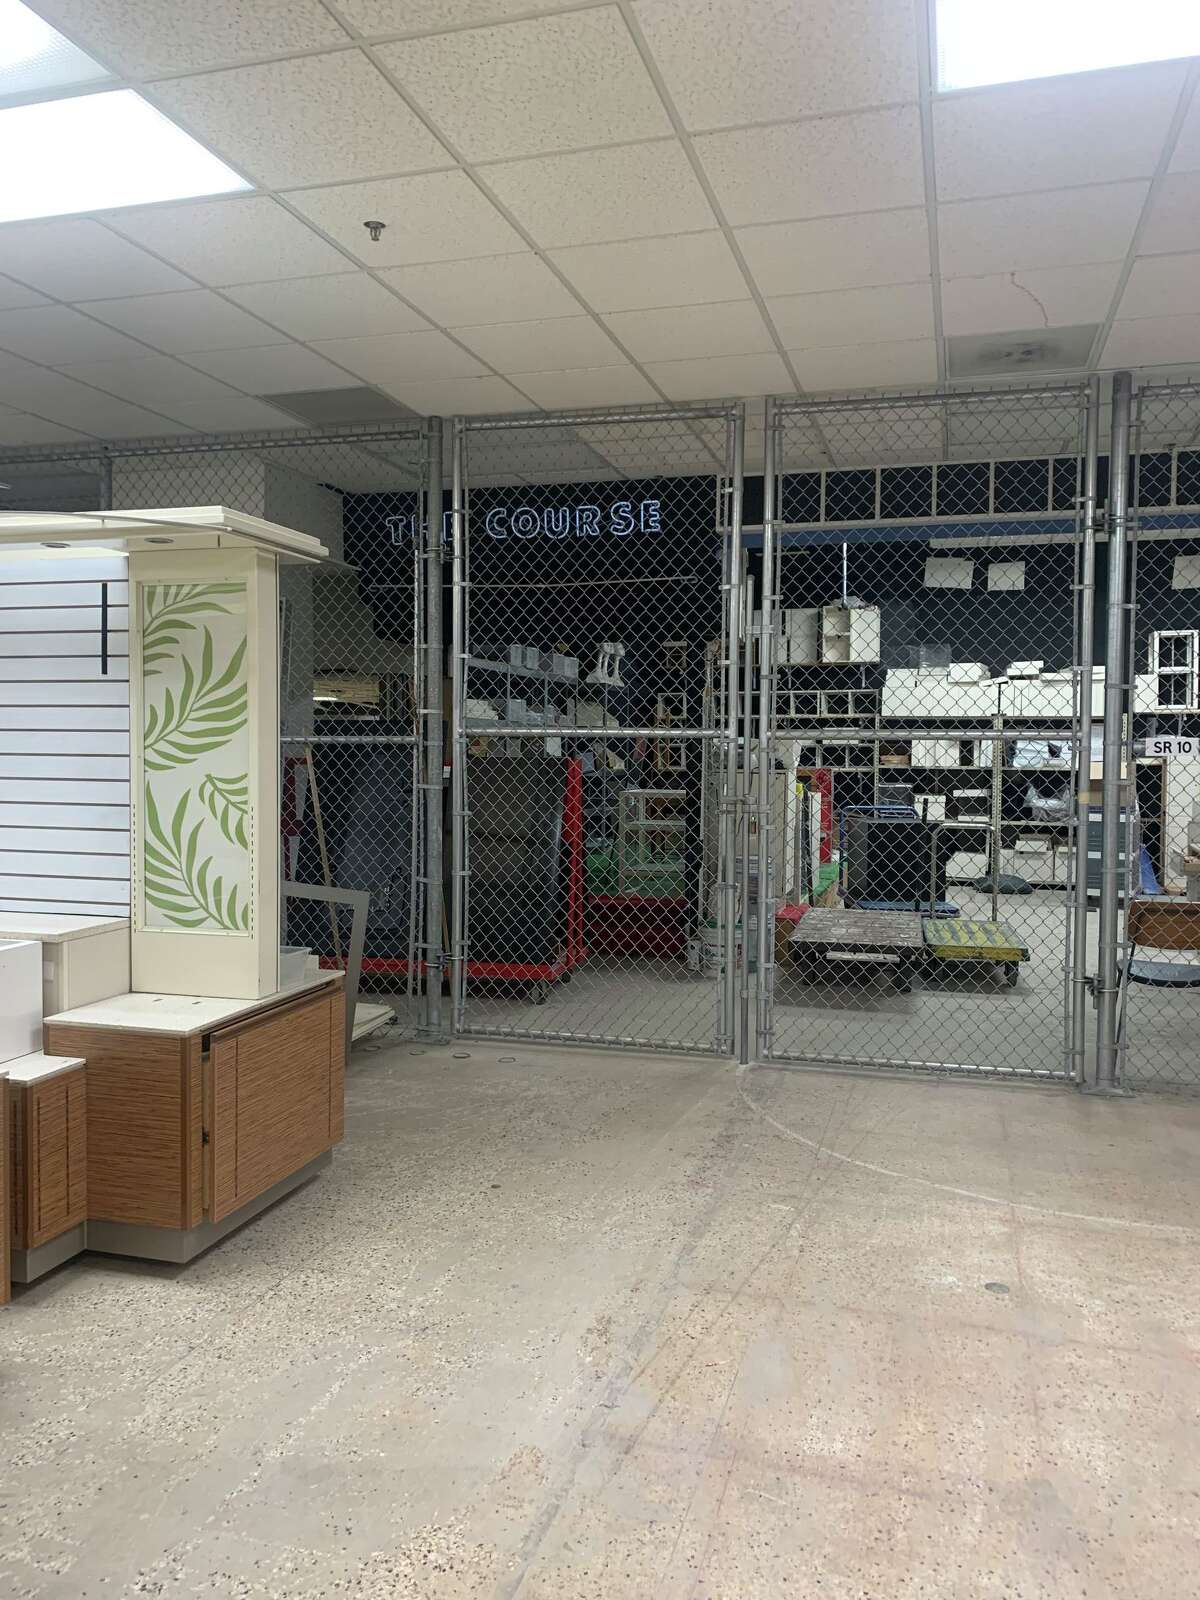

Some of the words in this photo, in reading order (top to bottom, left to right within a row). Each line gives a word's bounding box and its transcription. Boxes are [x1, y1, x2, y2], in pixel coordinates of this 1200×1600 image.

[486, 499, 662, 539] COURSE
[1154, 741, 1172, 753] SR
[1177, 741, 1192, 753] 10
